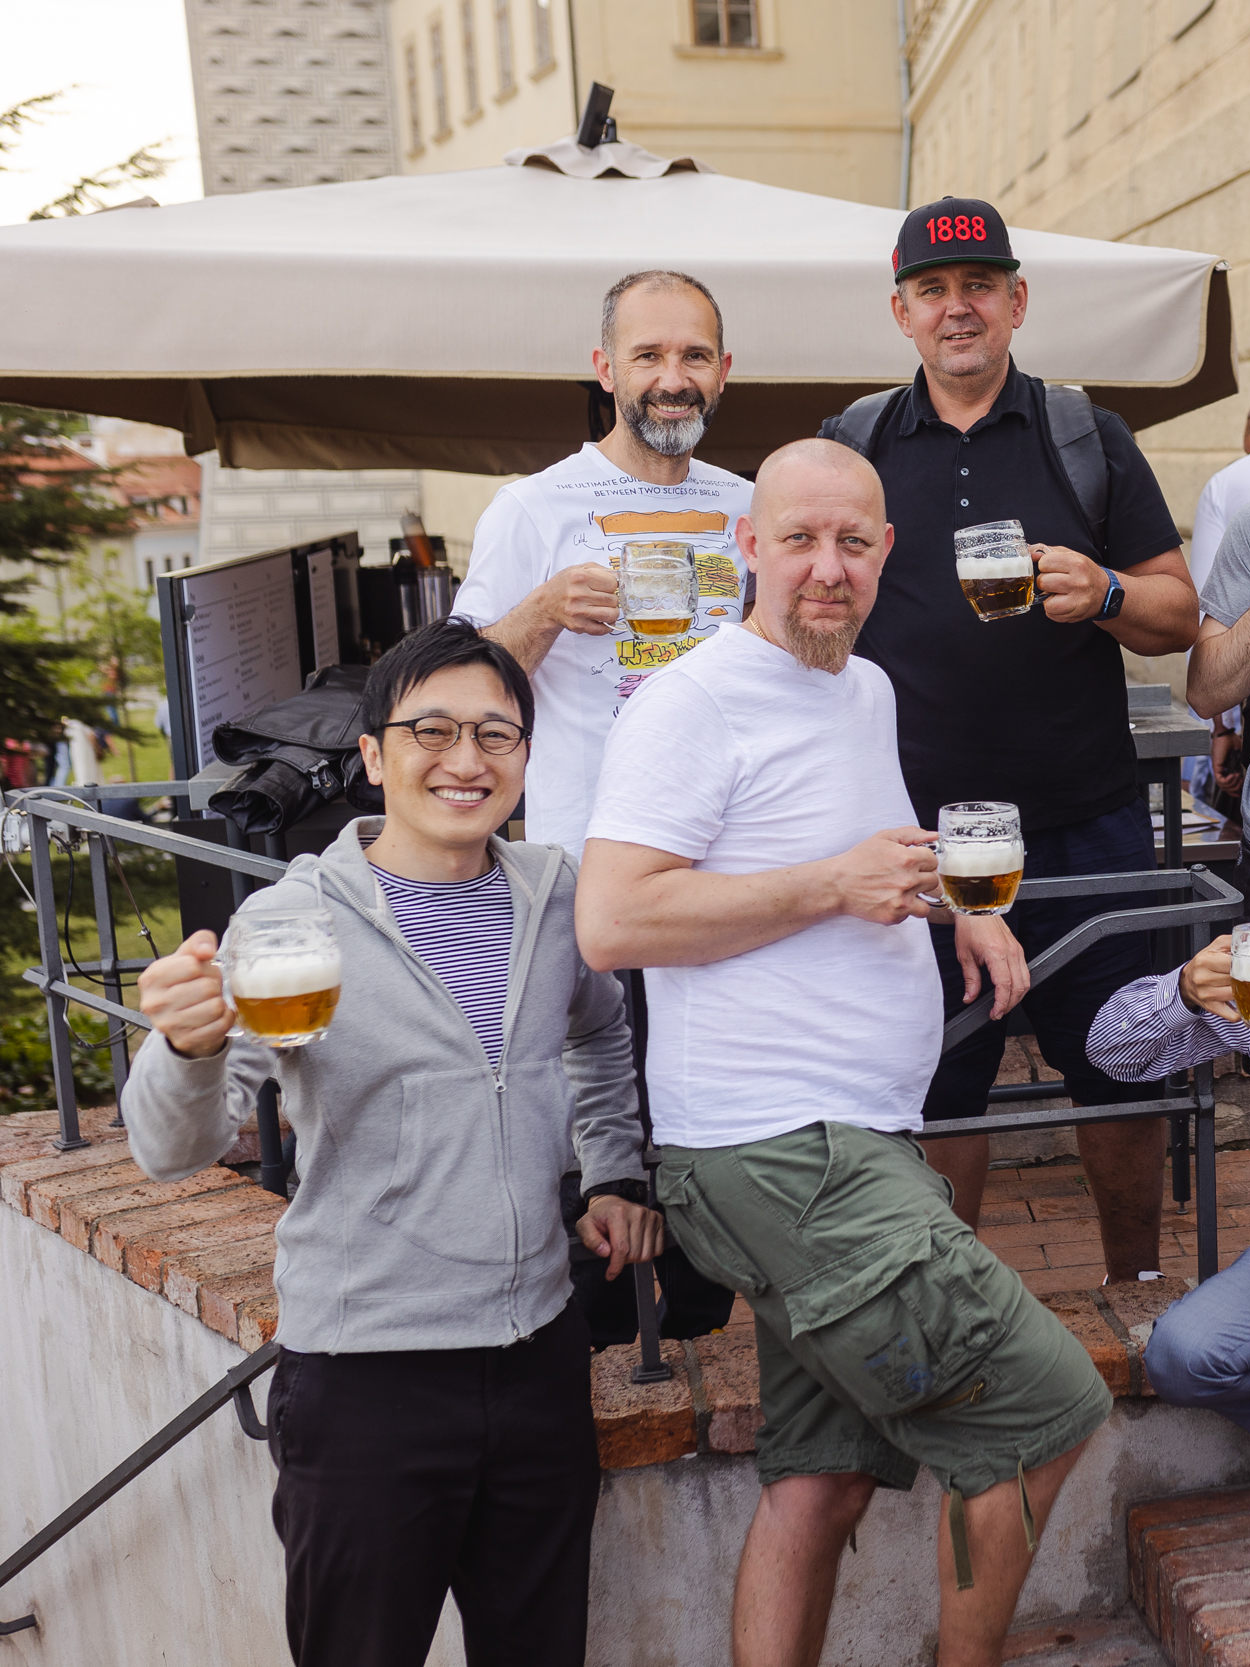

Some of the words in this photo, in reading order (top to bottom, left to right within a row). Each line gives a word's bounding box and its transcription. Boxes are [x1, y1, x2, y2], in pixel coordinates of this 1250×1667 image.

[926, 215, 987, 244] 1888
[575, 479, 618, 489] ULTIMATE
[594, 488, 636, 497] BETWEEN
[662, 487, 688, 495] SLICES
[689, 488, 698, 496] OF
